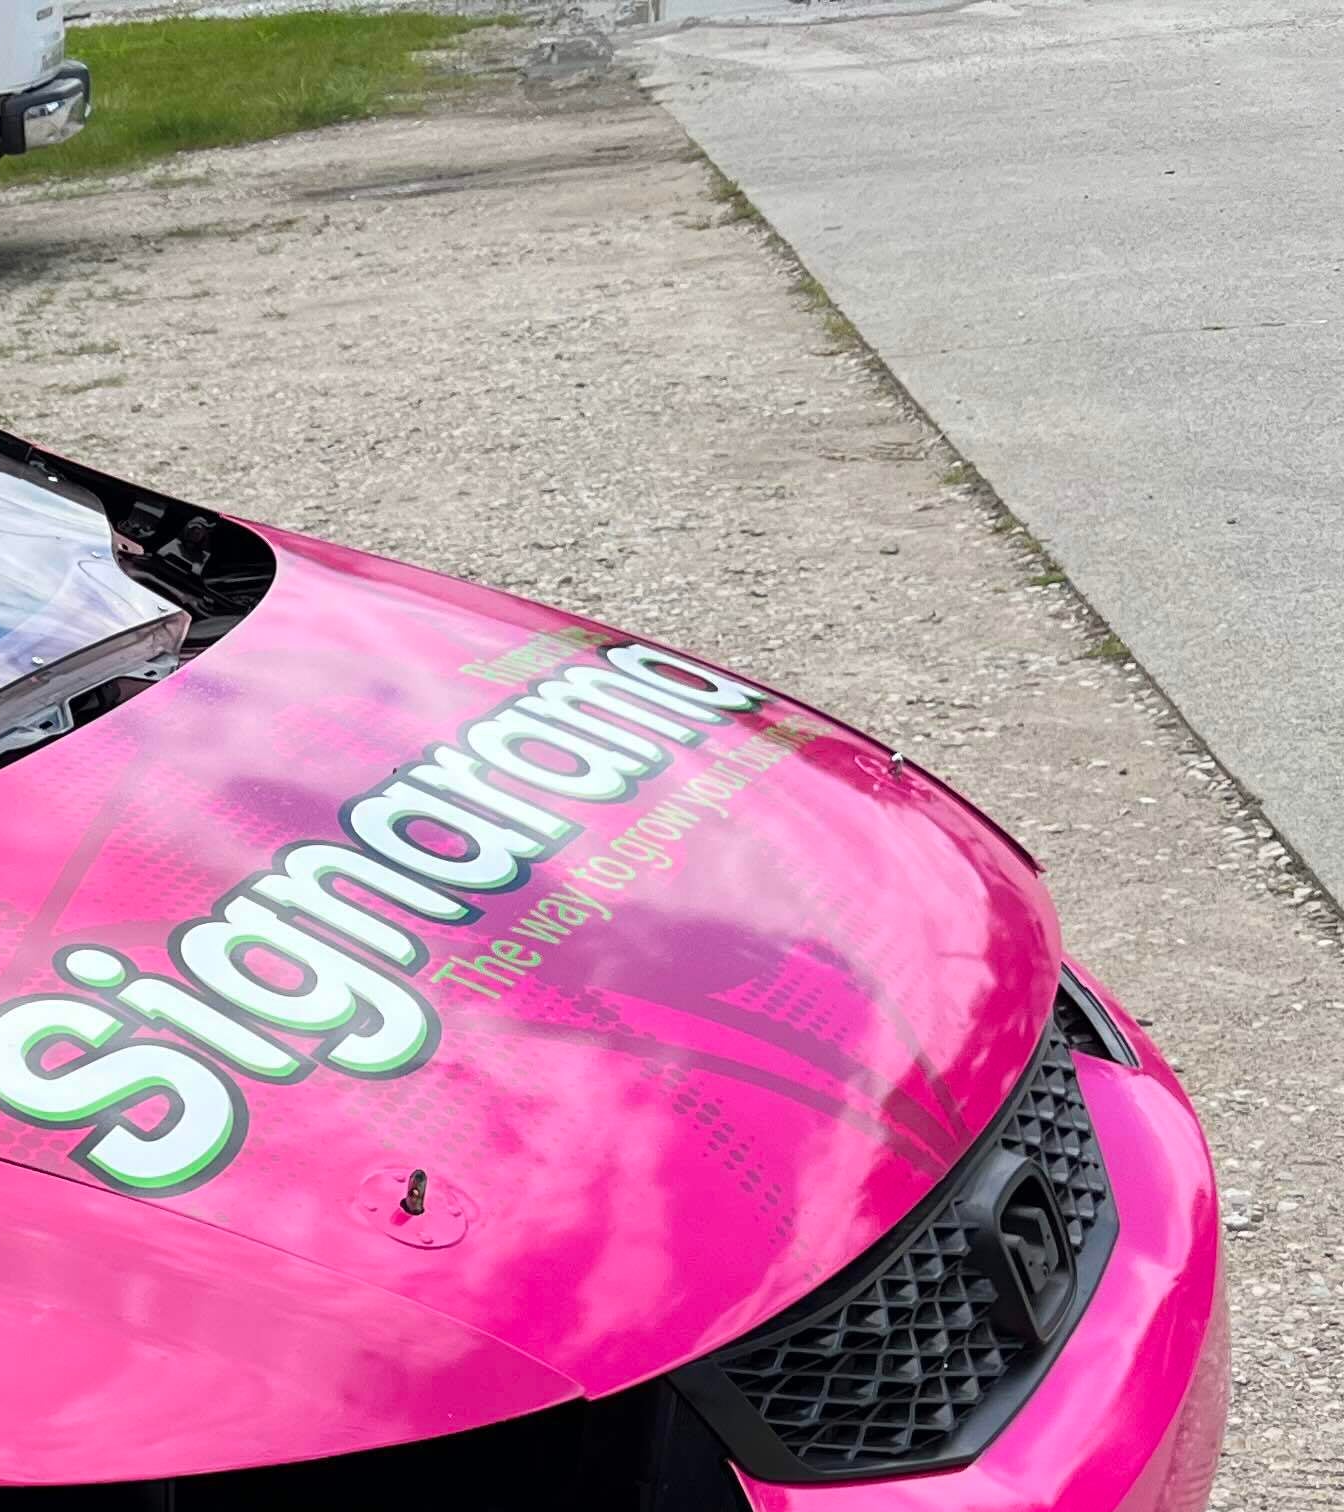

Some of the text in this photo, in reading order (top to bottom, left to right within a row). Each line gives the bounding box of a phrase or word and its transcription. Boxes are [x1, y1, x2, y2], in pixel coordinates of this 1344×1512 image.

[431, 937, 542, 1000] The
[511, 882, 612, 945] way
[573, 854, 637, 890] to
[610, 794, 702, 869] grow
[680, 756, 753, 819] your
